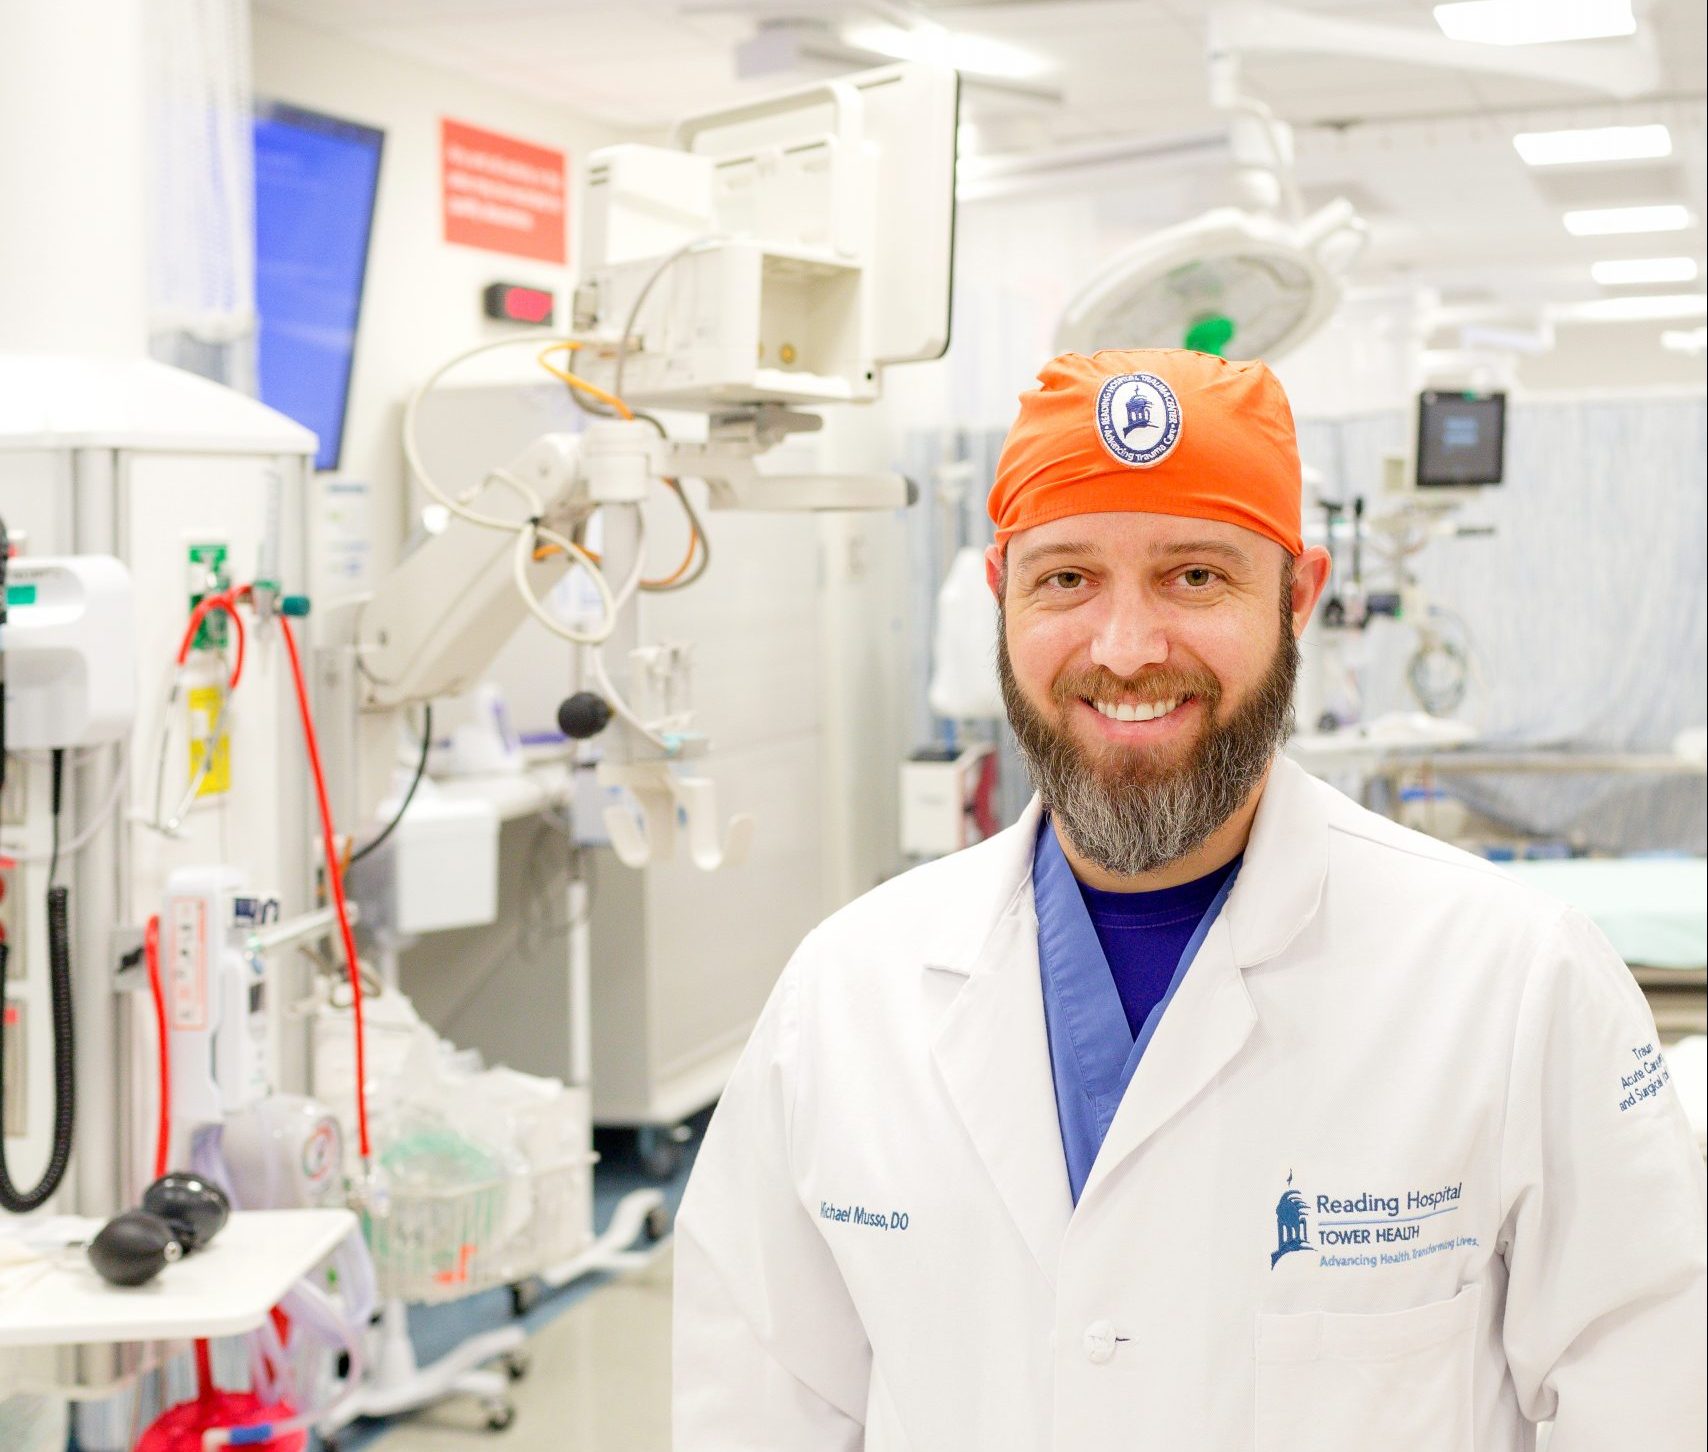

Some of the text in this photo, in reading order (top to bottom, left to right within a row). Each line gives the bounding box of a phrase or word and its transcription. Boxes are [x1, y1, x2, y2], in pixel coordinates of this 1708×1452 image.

[1101, 374, 1178, 426] READING HOSPITAL TRAUMA CENTER
[1103, 429, 1135, 461] Advancing
[1135, 445, 1167, 461] Trauma
[1619, 1093, 1637, 1112] and
[1634, 1075, 1664, 1101] Surgical
[1621, 1069, 1645, 1090] Acute
[1316, 1182, 1463, 1217] Reading Hospital
[853, 1206, 889, 1231] Musso,
[890, 1211, 909, 1231] DO
[1318, 1225, 1420, 1246] TOWER HEALTH
[1319, 1254, 1378, 1268] Advancing
[1412, 1241, 1455, 1260] Transforming
